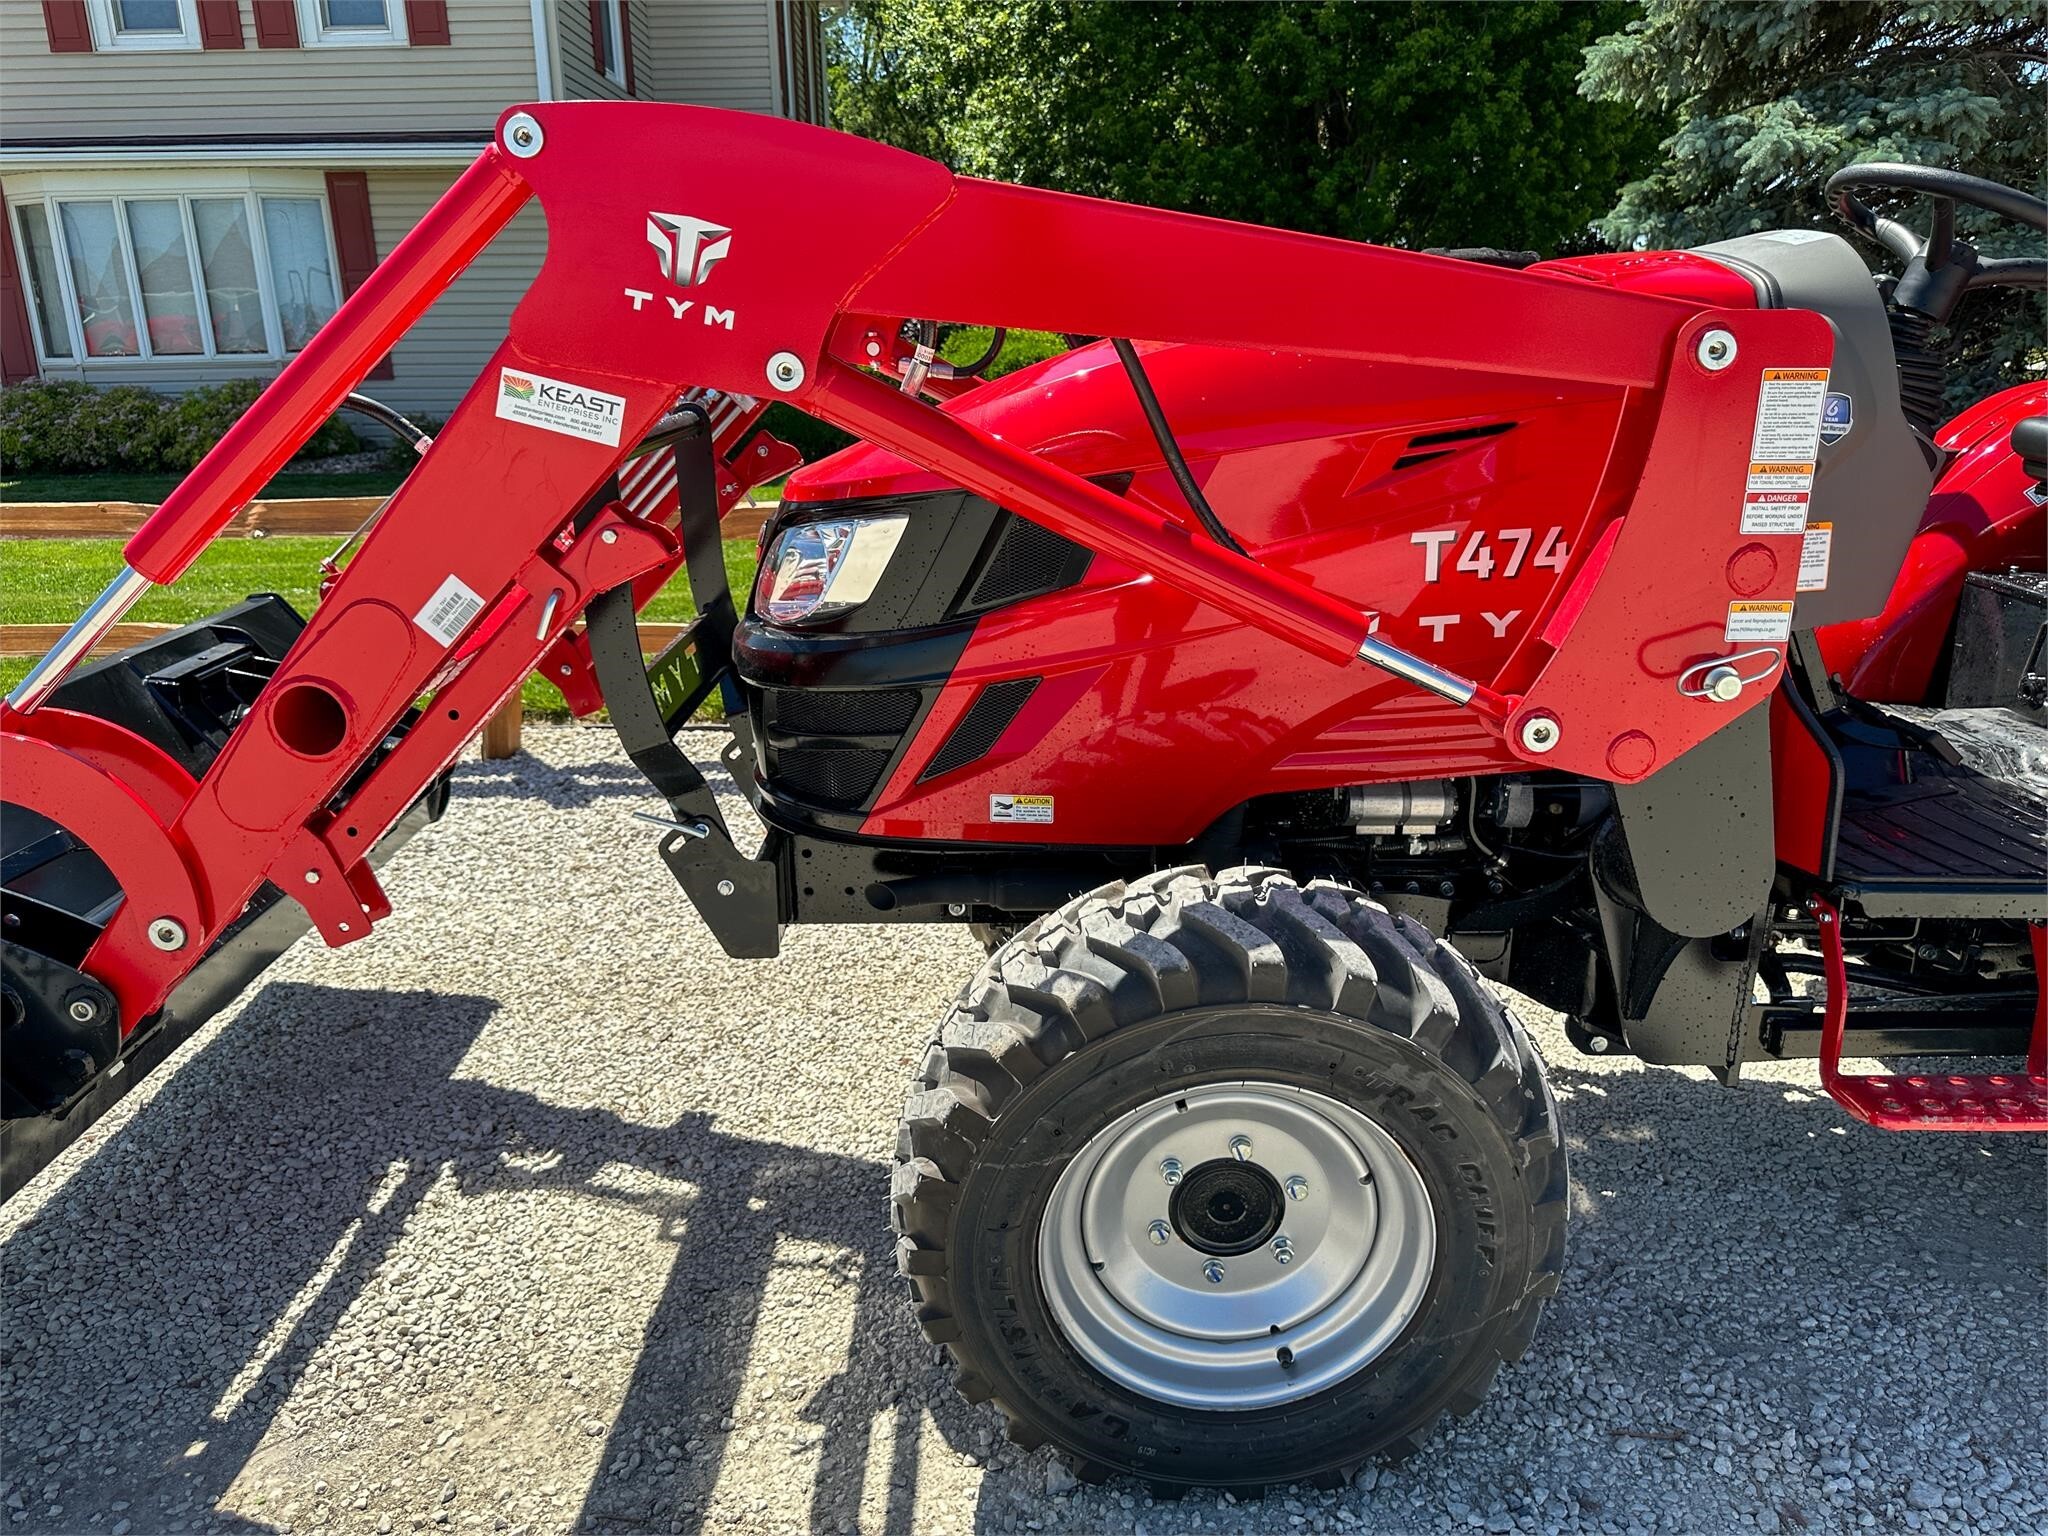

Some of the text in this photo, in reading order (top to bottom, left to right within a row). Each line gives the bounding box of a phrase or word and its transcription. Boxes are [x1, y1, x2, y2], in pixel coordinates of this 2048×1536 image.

[624, 288, 736, 331] TYM
[1782, 372, 1819, 380] WARNING
[539, 384, 621, 416] KEAST
[1826, 400, 1839, 417] 6
[538, 399, 618, 426] ENTERPRISES INC
[1768, 465, 1804, 473] WARNING
[1766, 494, 1798, 502] DANGER
[1410, 526, 1570, 582] T474
[1748, 604, 1783, 612] WARNING
[1419, 610, 1522, 643] TY
